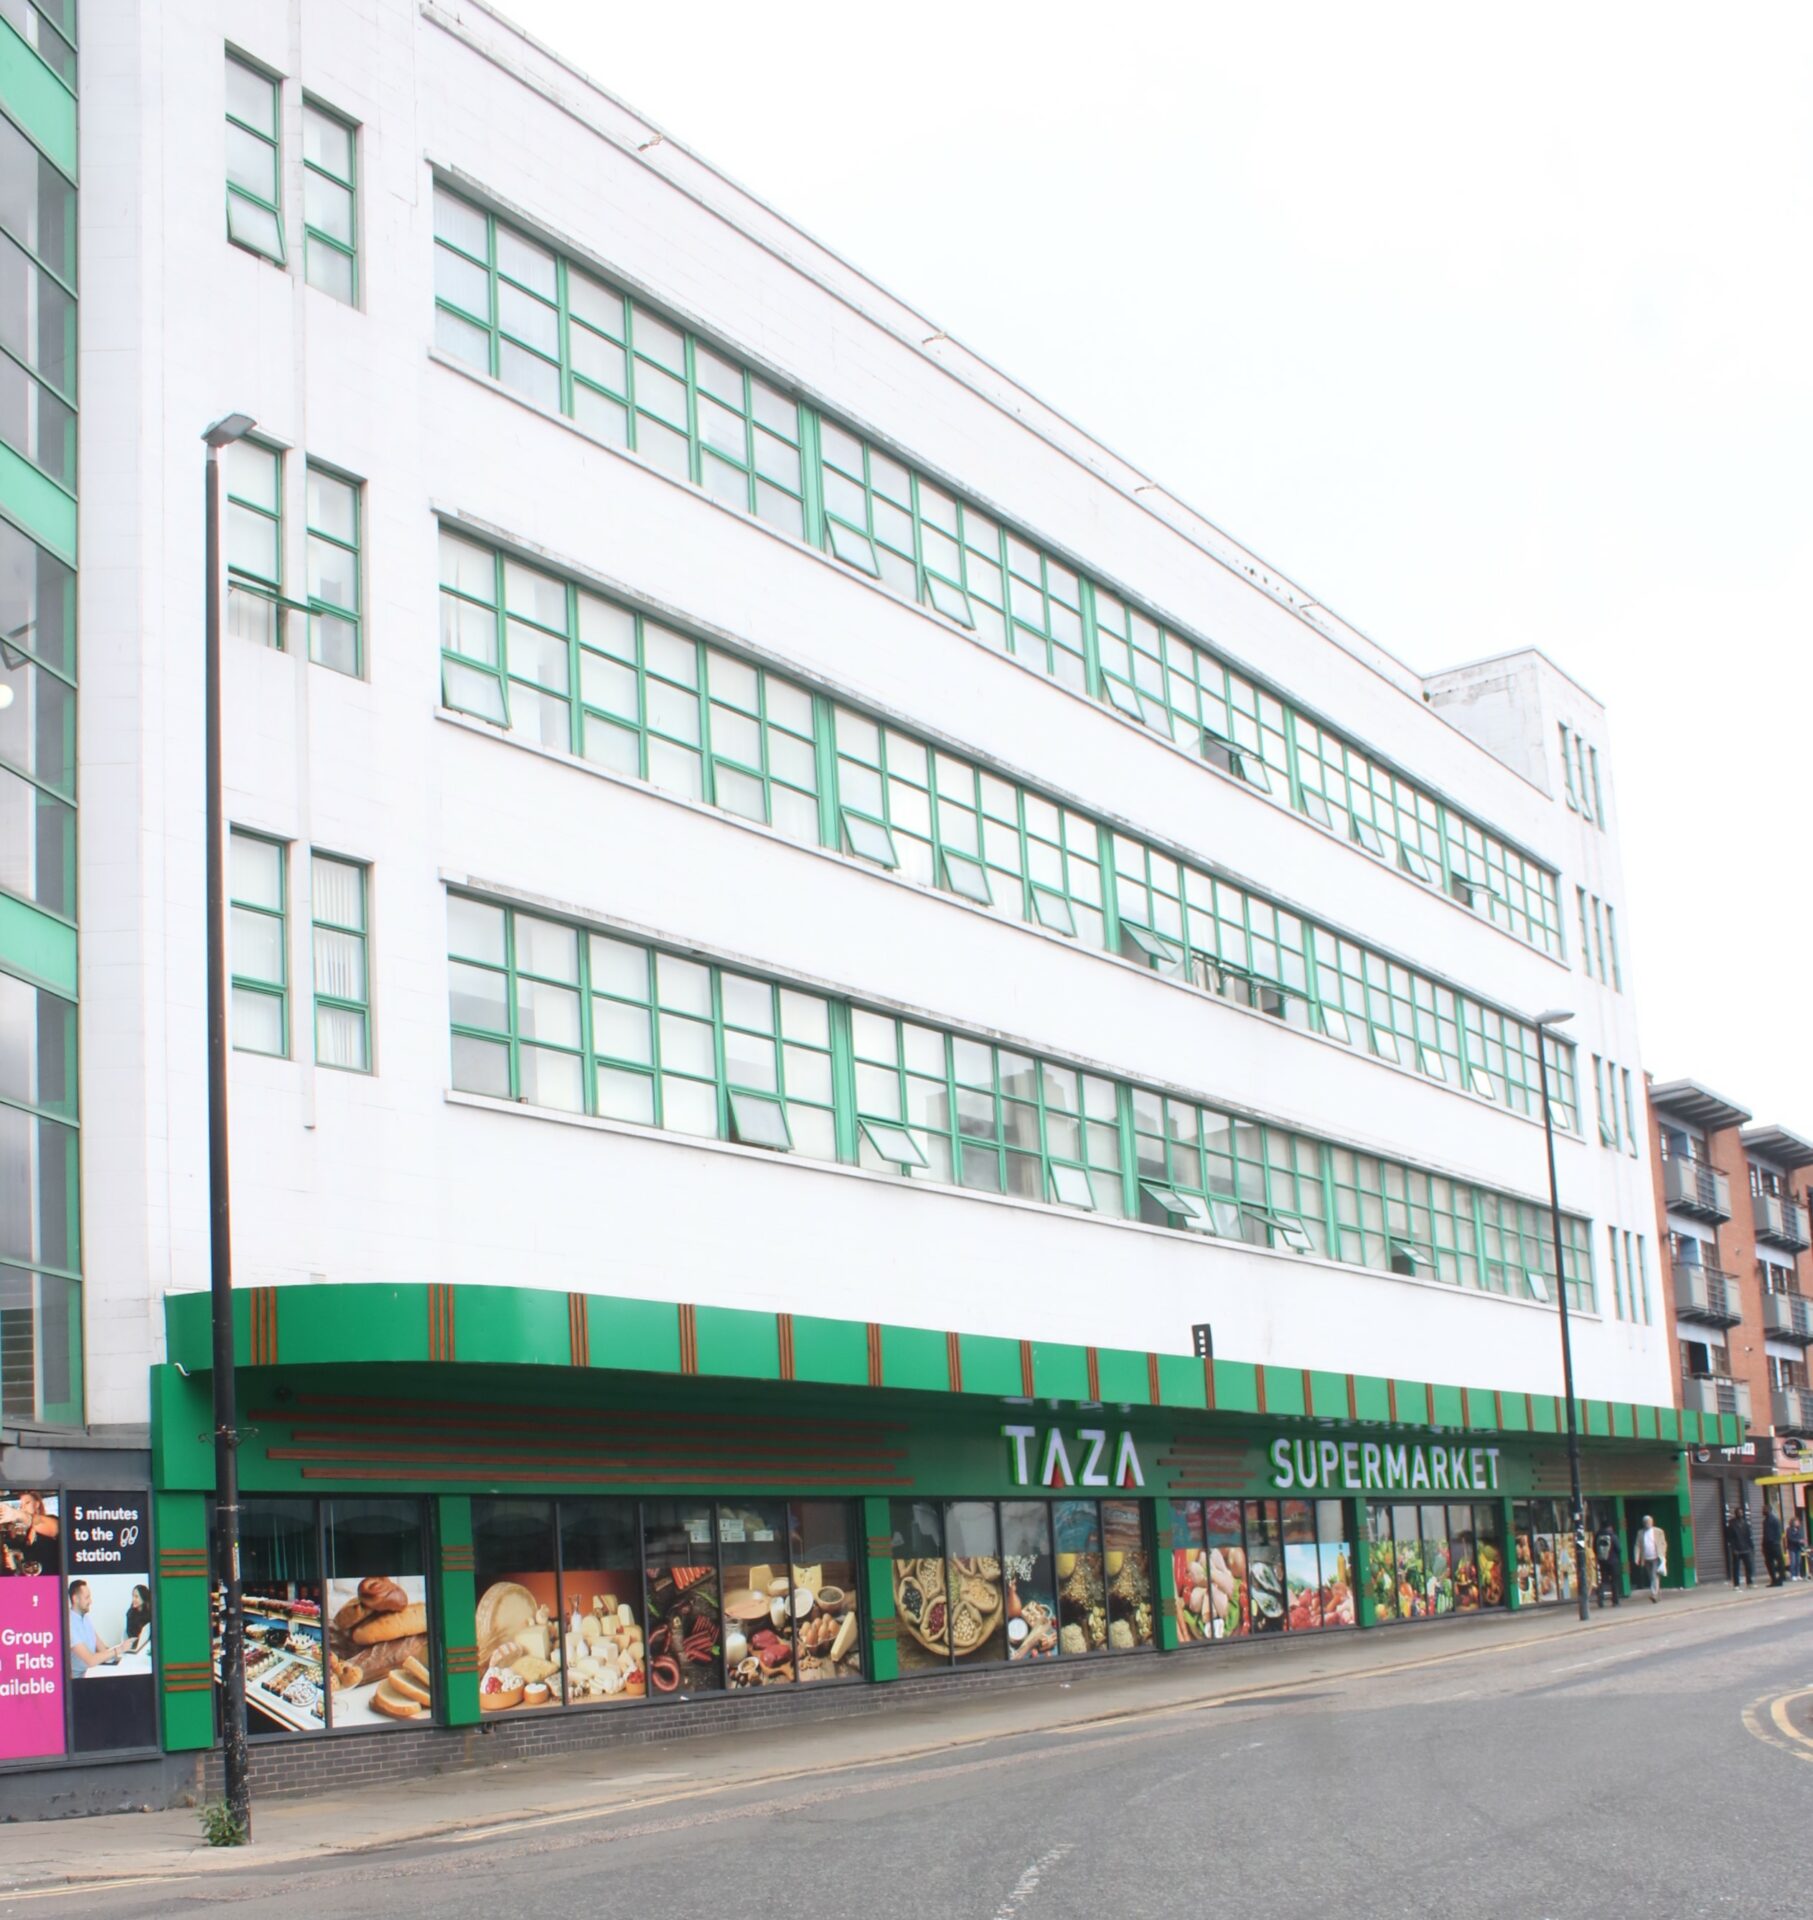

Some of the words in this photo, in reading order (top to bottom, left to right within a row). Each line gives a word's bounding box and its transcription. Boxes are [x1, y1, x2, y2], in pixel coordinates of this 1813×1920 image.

[1001, 1425, 1145, 1488] TAZA
[1270, 1438, 1500, 1490] SUPERMARKET
[74, 1506, 83, 1520] 5
[86, 1506, 138, 1520] minutes
[75, 1528, 89, 1541] to
[91, 1527, 114, 1541] the
[75, 1547, 121, 1562] station
[1, 1628, 54, 1648] Group
[15, 1653, 55, 1670] Flats
